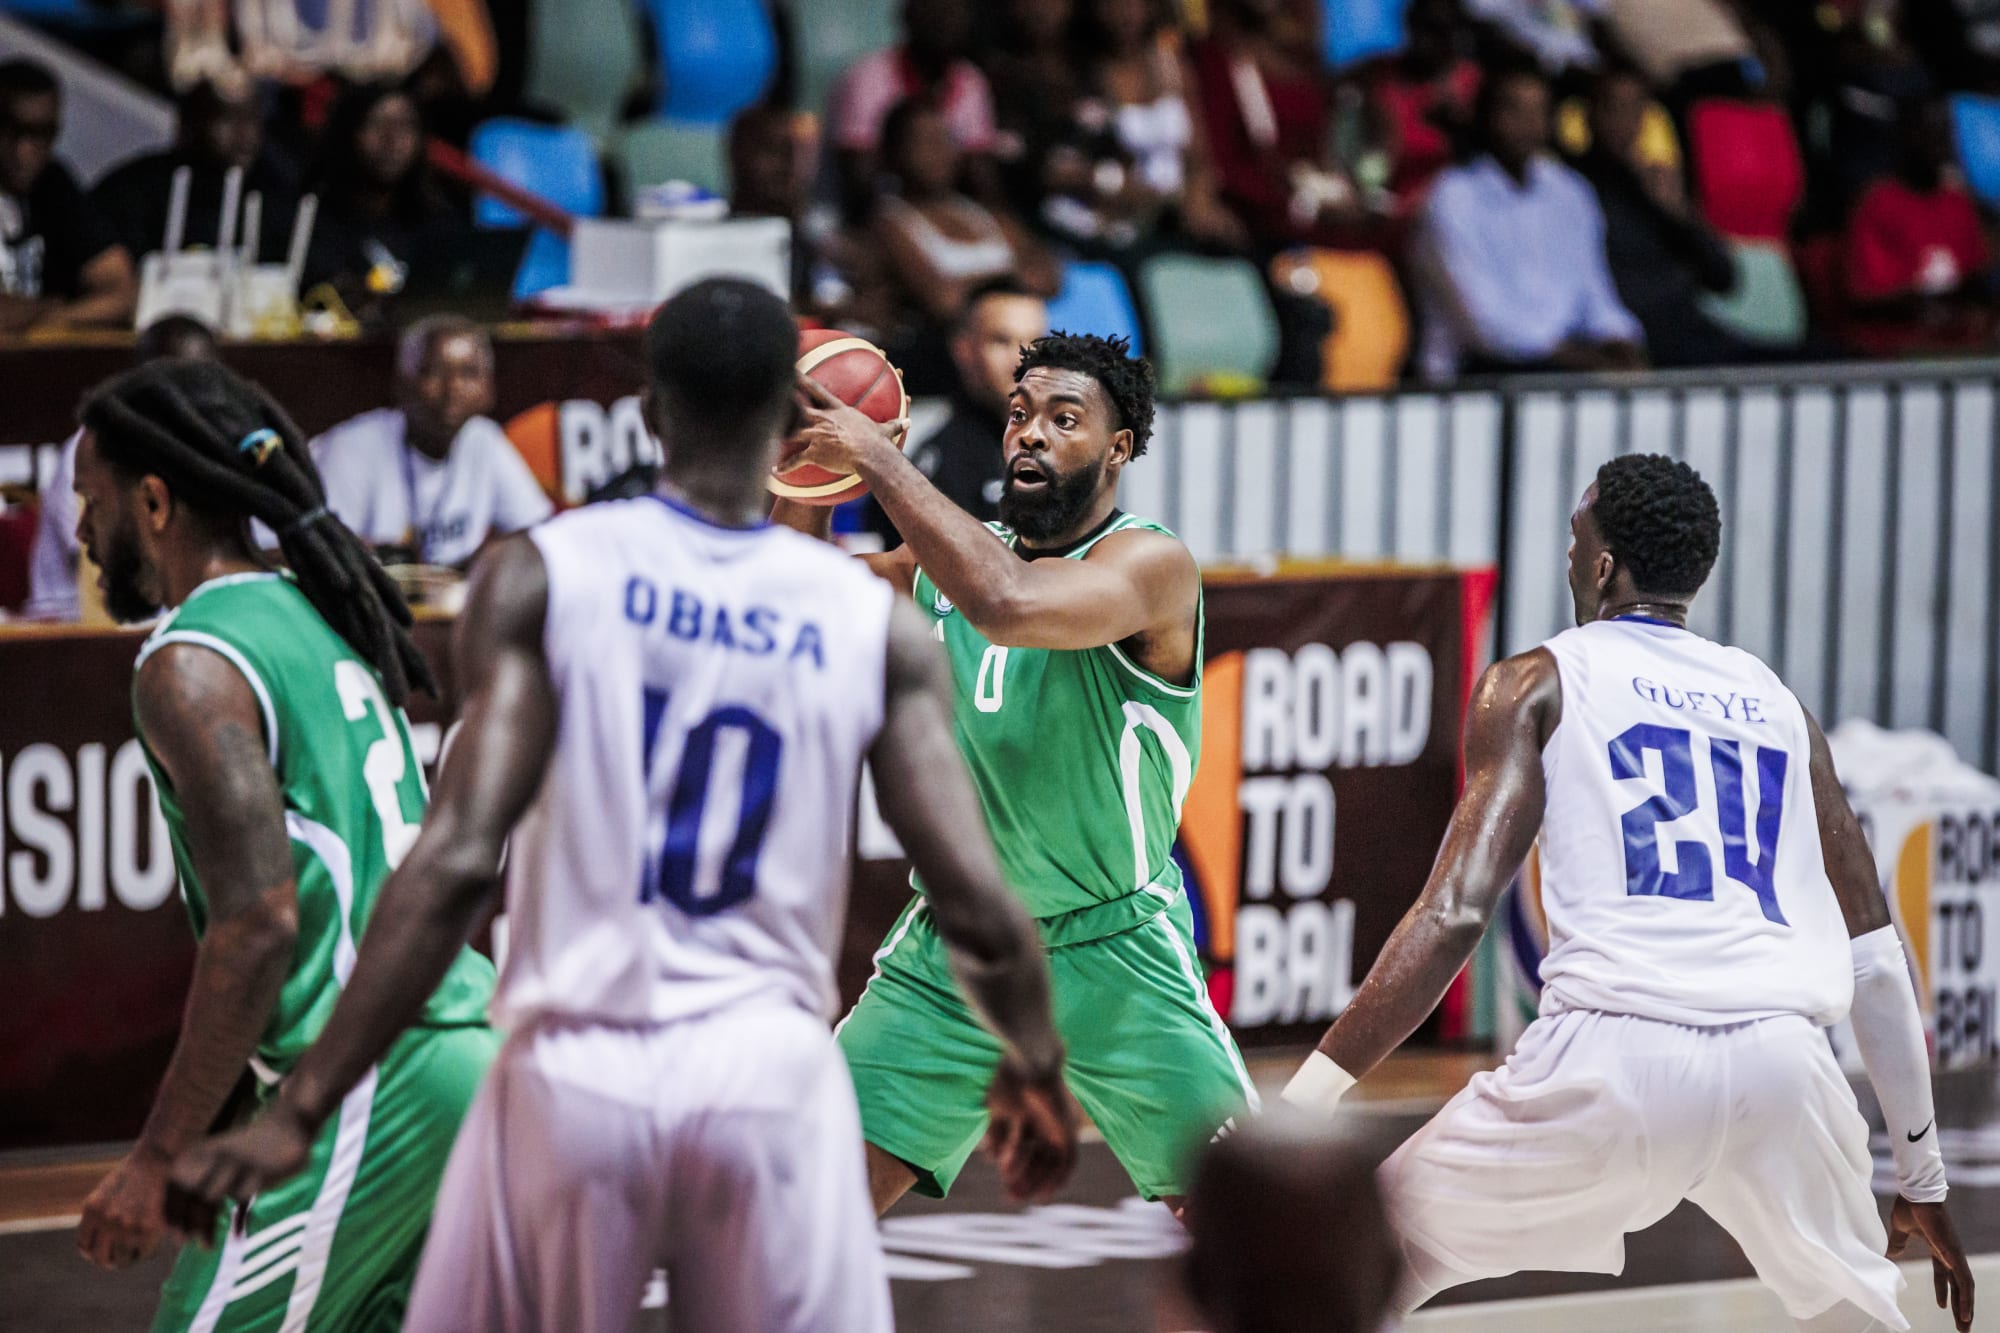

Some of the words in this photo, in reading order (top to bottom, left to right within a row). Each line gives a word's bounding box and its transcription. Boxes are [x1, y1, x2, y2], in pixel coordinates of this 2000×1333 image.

[622, 574, 828, 671] OBASA
[974, 643, 1009, 713] 0
[1242, 640, 1434, 770] ROAD
[0, 737, 188, 918] SIO
[1238, 774, 1337, 900] TO
[1607, 721, 1791, 928] 24
[1233, 899, 1360, 1028] BAL
